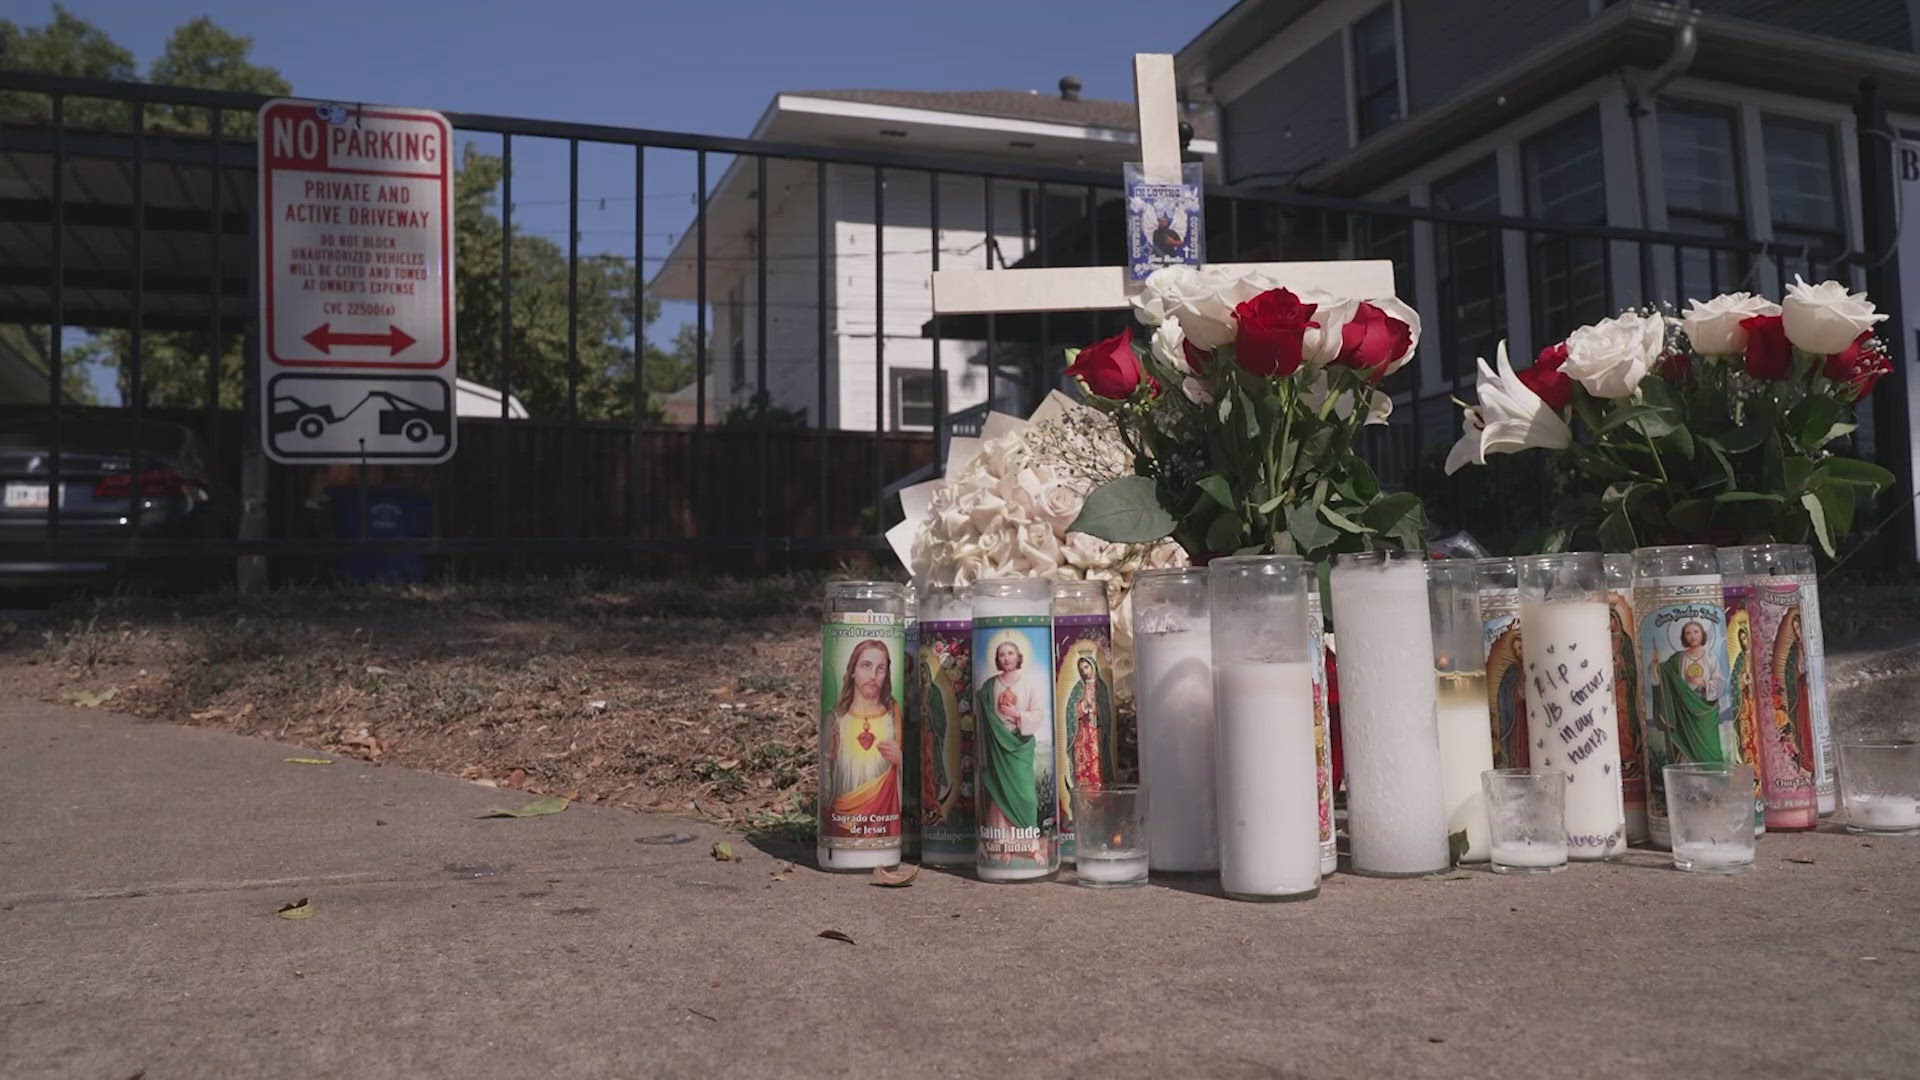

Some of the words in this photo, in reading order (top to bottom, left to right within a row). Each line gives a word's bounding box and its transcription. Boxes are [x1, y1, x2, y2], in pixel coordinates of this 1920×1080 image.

[273, 117, 319, 160] NO
[333, 128, 436, 162] PARKING
[305, 180, 370, 202] PRIVATE
[377, 185, 410, 204] AND
[285, 204, 342, 224] ACTIVE
[350, 207, 430, 229] DRIVEWAY
[321, 233, 335, 247] DO
[339, 234, 359, 248] NOT
[363, 235, 396, 249] BLOCK
[291, 247, 372, 264] UNAUTHORIZED
[375, 251, 425, 266] VEHICLES
[289, 263, 315, 276] WILL
[319, 265, 332, 276] BE
[336, 265, 365, 278] CITED
[370, 267, 391, 279] AND
[395, 267, 427, 280] TOWED
[303, 278, 315, 291] AT
[320, 279, 366, 293] OWNER'S
[370, 281, 415, 296] EXPENSE
[323, 301, 343, 315] CVC
[856, 628, 883, 638] Heart
[831, 813, 868, 824] Sagrado
[849, 825, 862, 834] de
[980, 826, 1006, 839] Saint
[1010, 826, 1041, 840] Jude
